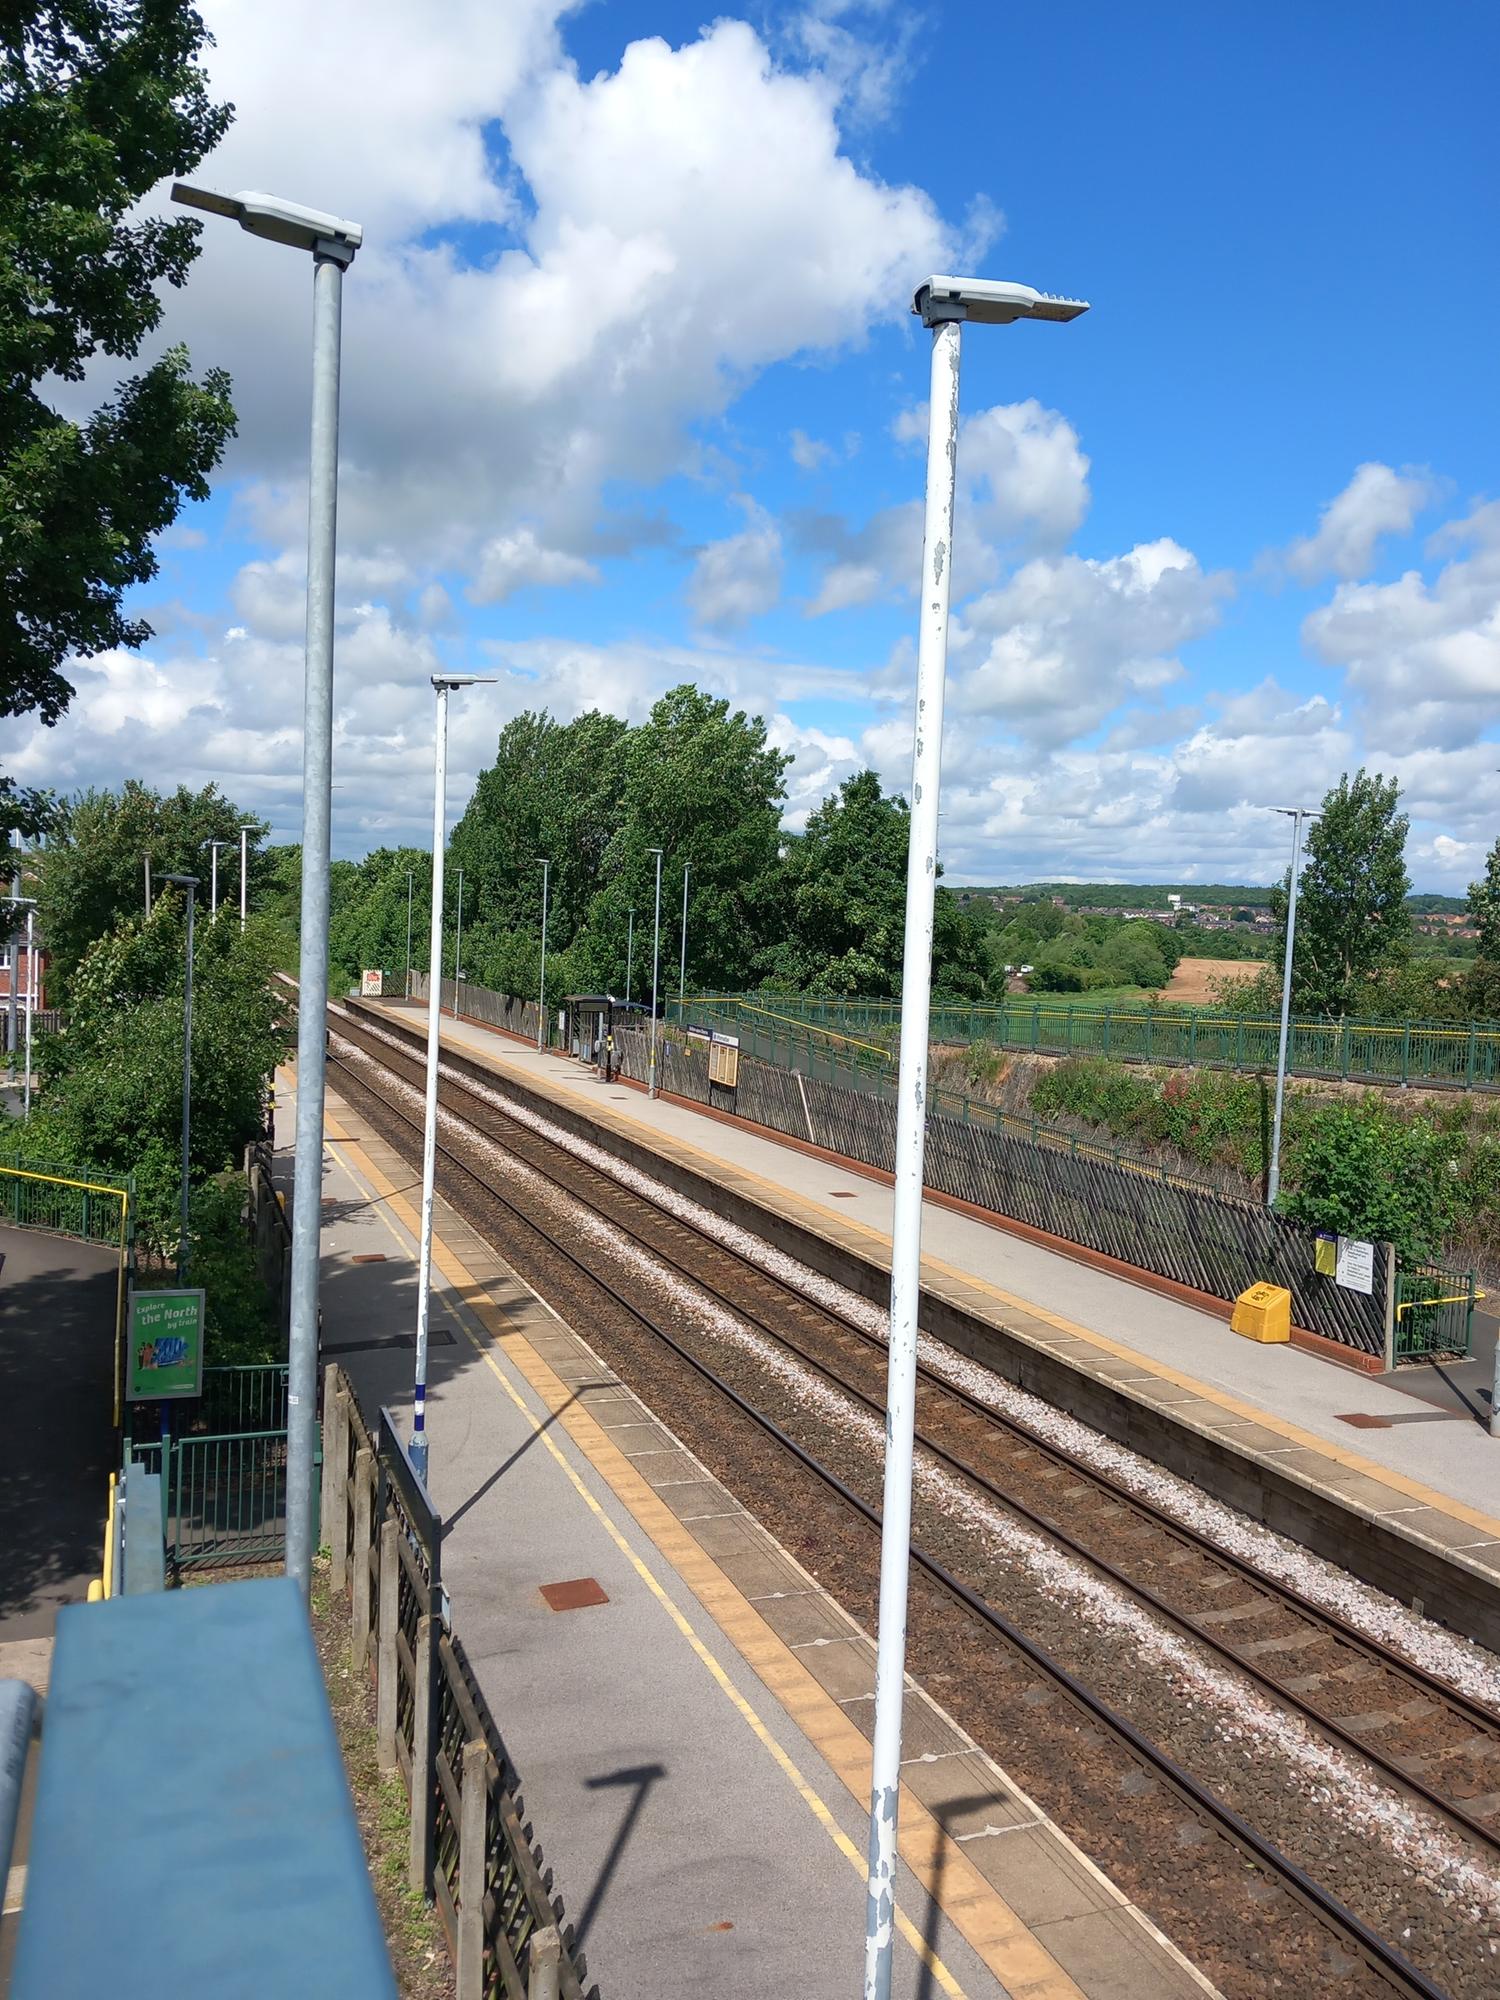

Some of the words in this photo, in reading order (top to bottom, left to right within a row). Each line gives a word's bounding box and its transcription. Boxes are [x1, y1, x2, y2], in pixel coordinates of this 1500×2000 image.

[136, 1303, 165, 1314] Explore
[142, 1314, 161, 1325] the
[164, 1306, 197, 1320] North
[178, 1319, 197, 1327] train
